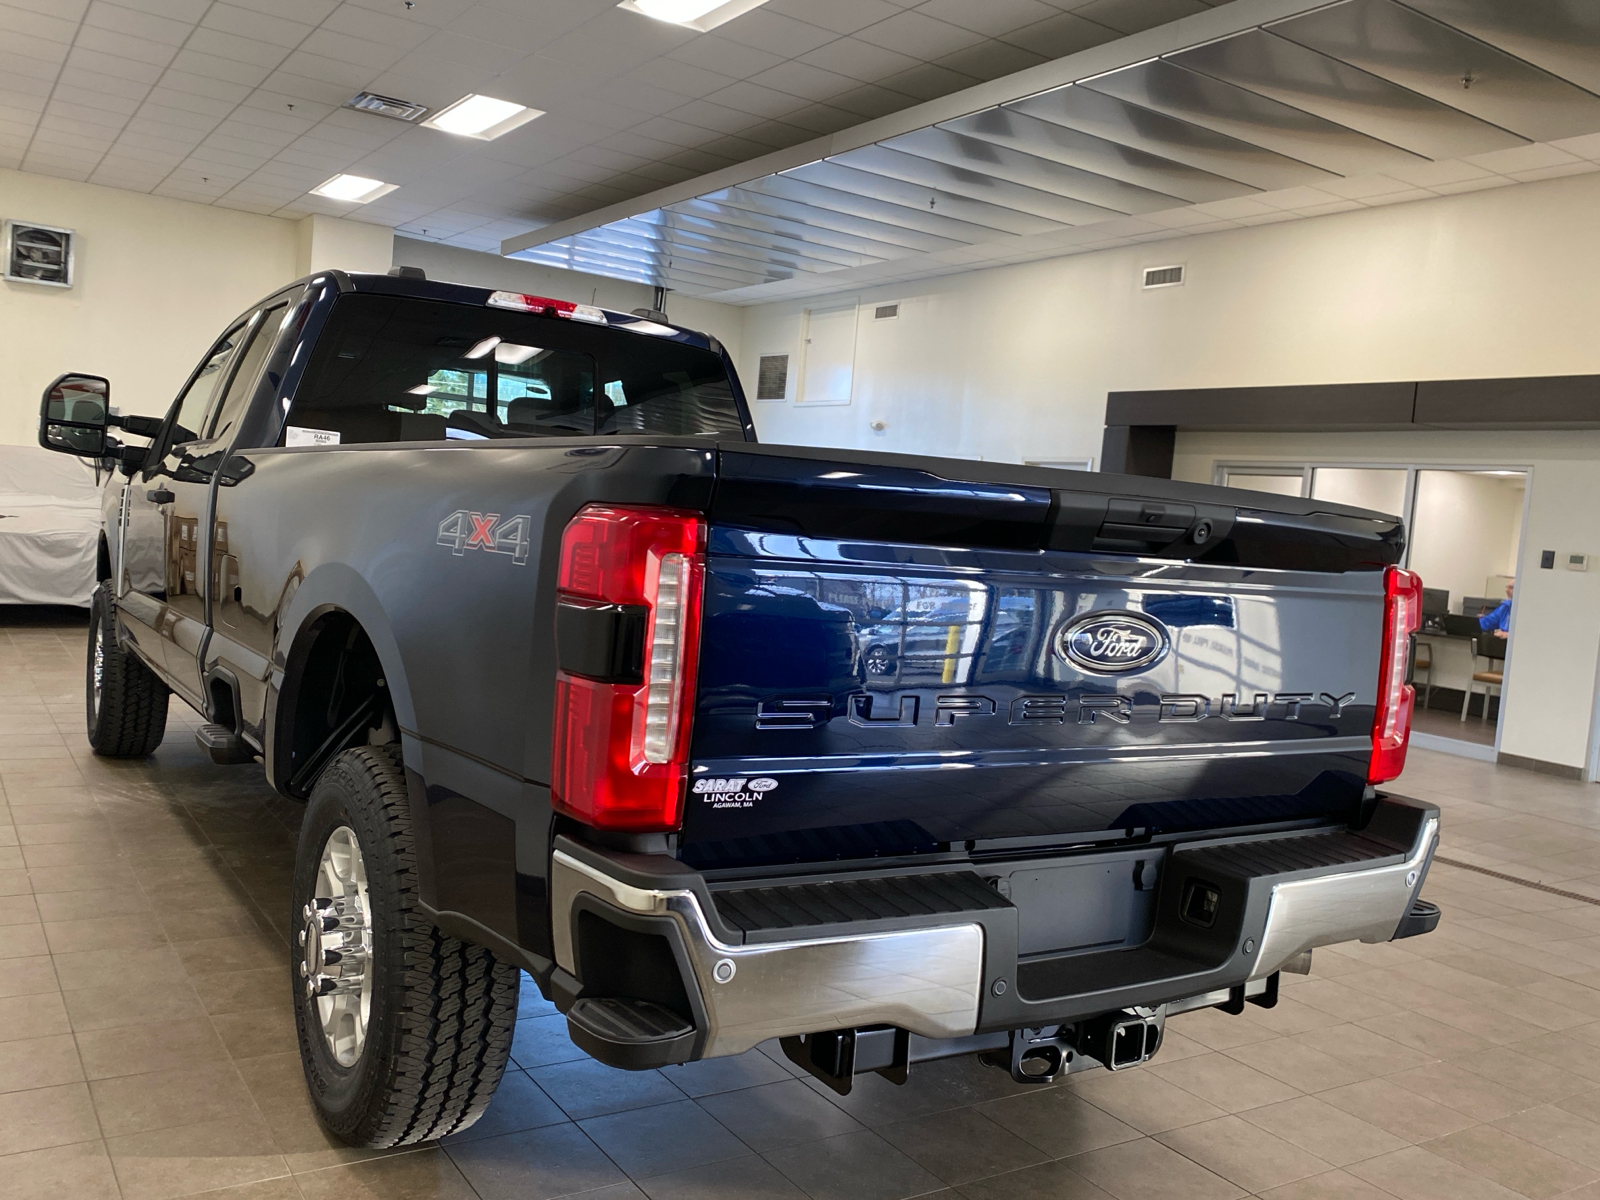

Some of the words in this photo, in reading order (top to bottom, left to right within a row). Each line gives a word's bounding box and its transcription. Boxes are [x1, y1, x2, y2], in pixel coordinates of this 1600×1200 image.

[314, 433, 330, 441] RA46
[1090, 624, 1141, 657] Ford
[755, 694, 1134, 730] SUPER
[1159, 692, 1356, 723] DUTY
[692, 778, 748, 793] SARAT
[751, 779, 775, 790] Ford
[703, 792, 763, 802] LINCOLN
